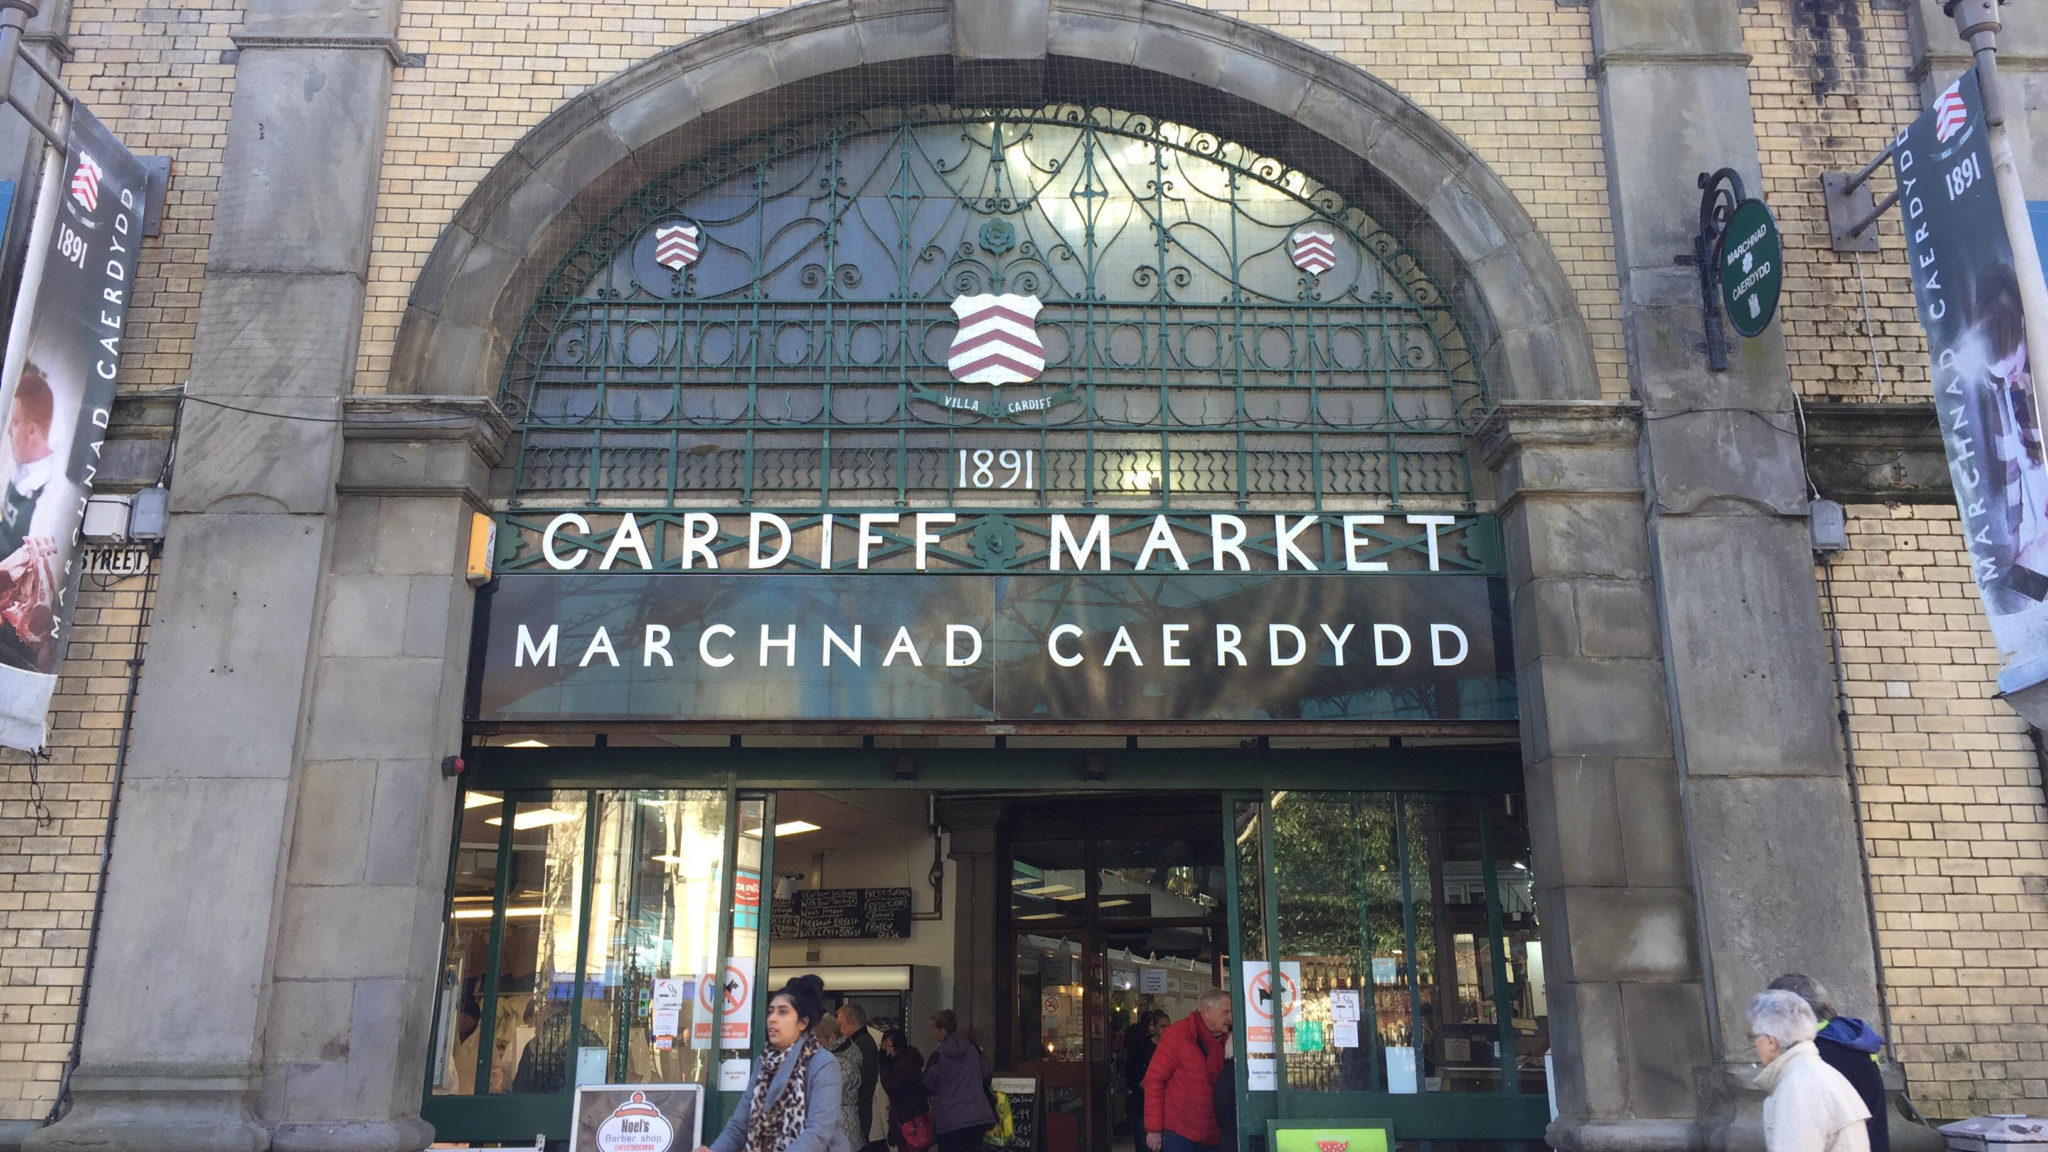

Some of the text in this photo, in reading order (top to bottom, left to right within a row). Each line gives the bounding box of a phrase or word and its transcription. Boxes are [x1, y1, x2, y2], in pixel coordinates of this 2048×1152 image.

[1946, 151, 1982, 201] 1891
[57, 222, 88, 269] 1891
[1727, 223, 1767, 266] MARCHNAD
[97, 188, 133, 380] CAERDYDD
[1732, 261, 1771, 301] CAERDYDD
[944, 396, 1052, 413] VILLA CARDIFF
[959, 449, 1033, 489] 1891
[1938, 348, 1999, 582] MARCHNAD
[542, 512, 956, 571] CARDIFF
[1049, 513, 1455, 572] MARKET
[514, 623, 1469, 667] MARCHNAD CAERDYDD
[605, 1134, 662, 1144] Barber shop
[621, 1118, 650, 1133] Noel's
